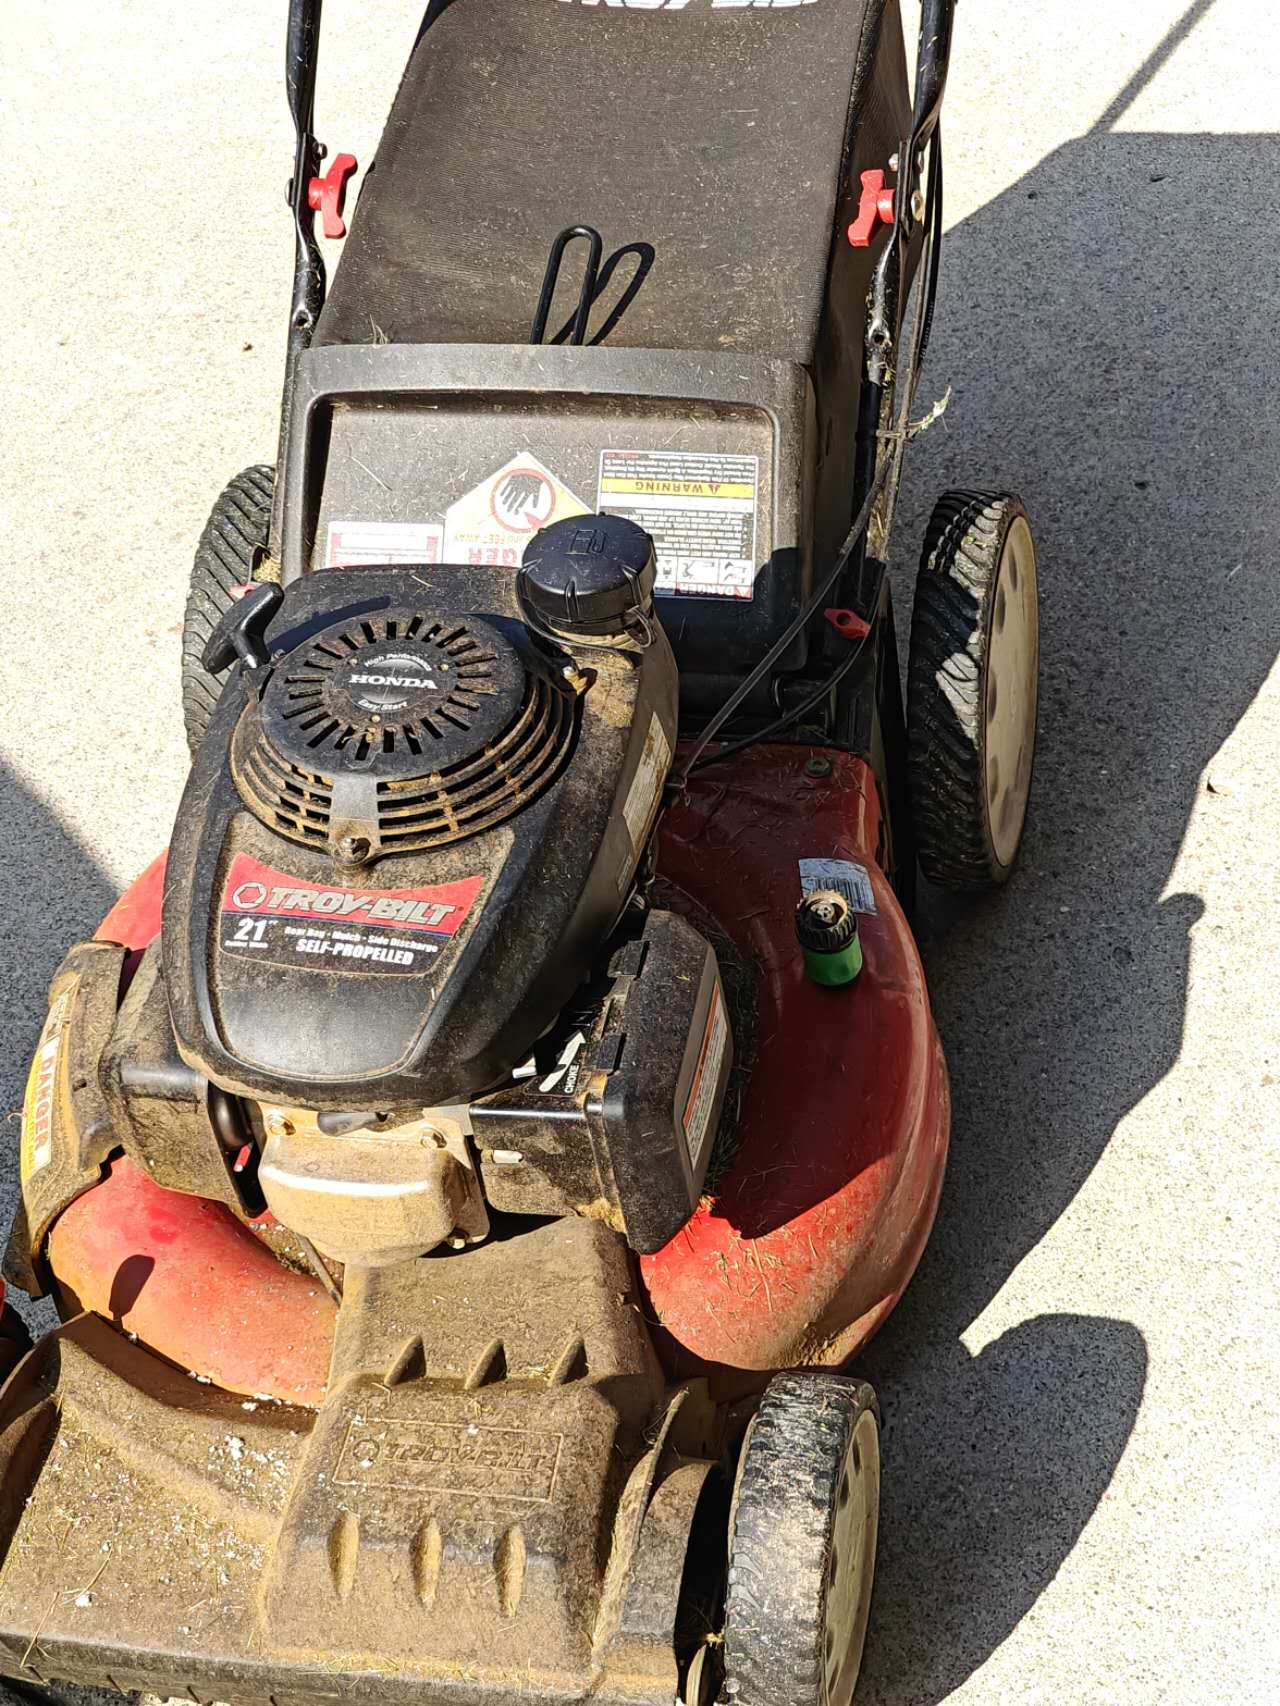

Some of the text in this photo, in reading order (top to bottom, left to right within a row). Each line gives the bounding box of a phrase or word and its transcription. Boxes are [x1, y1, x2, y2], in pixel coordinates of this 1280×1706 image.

[634, 481, 703, 494] WARNING
[468, 547, 518, 565] GER
[679, 583, 735, 596] DANGER
[364, 655, 385, 667] High
[348, 673, 439, 690] HONDA
[358, 698, 408, 712] Easy Start
[268, 886, 456, 925] TROY-BILT
[284, 925, 439, 953] Rear Bag Mulch Side Discharge
[295, 938, 415, 966] SELF-PROPELLED
[563, 1064, 580, 1096] CHOKE
[35, 1054, 55, 1149] DANGER
